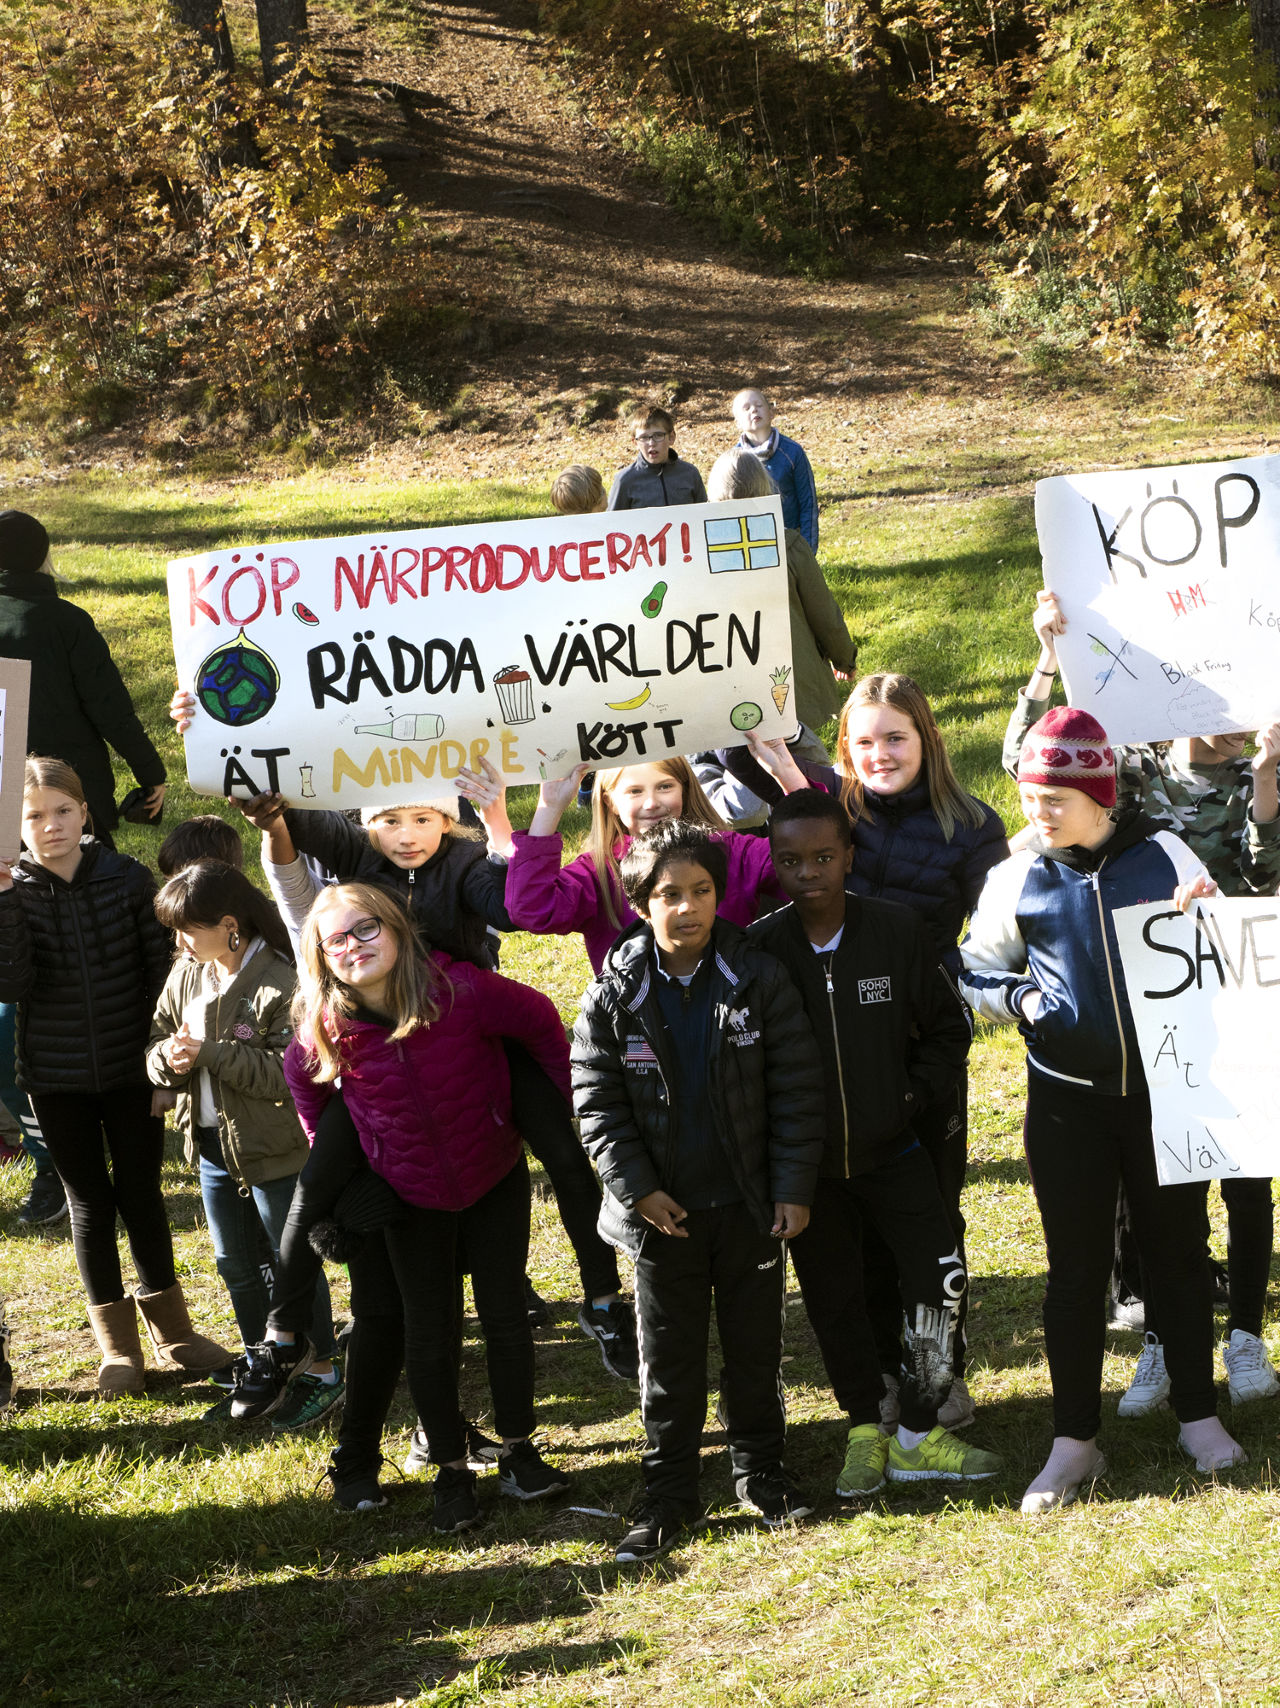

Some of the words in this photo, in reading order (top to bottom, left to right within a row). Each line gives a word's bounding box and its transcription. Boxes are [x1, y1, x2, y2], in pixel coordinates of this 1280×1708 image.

[1091, 472, 1261, 584] KÖP
[188, 552, 300, 627] KÖP
[334, 522, 692, 611] NÄRPRODUCERAT!
[307, 631, 486, 709] RÄDDA
[525, 610, 762, 687] VÄRLDEN
[1160, 660, 1202, 686] Black
[221, 744, 290, 801] ÄT
[576, 719, 684, 763] KÖTT
[860, 979, 888, 992] SOHO
[866, 989, 886, 1001] NYC
[744, 1030, 761, 1042] CLUB
